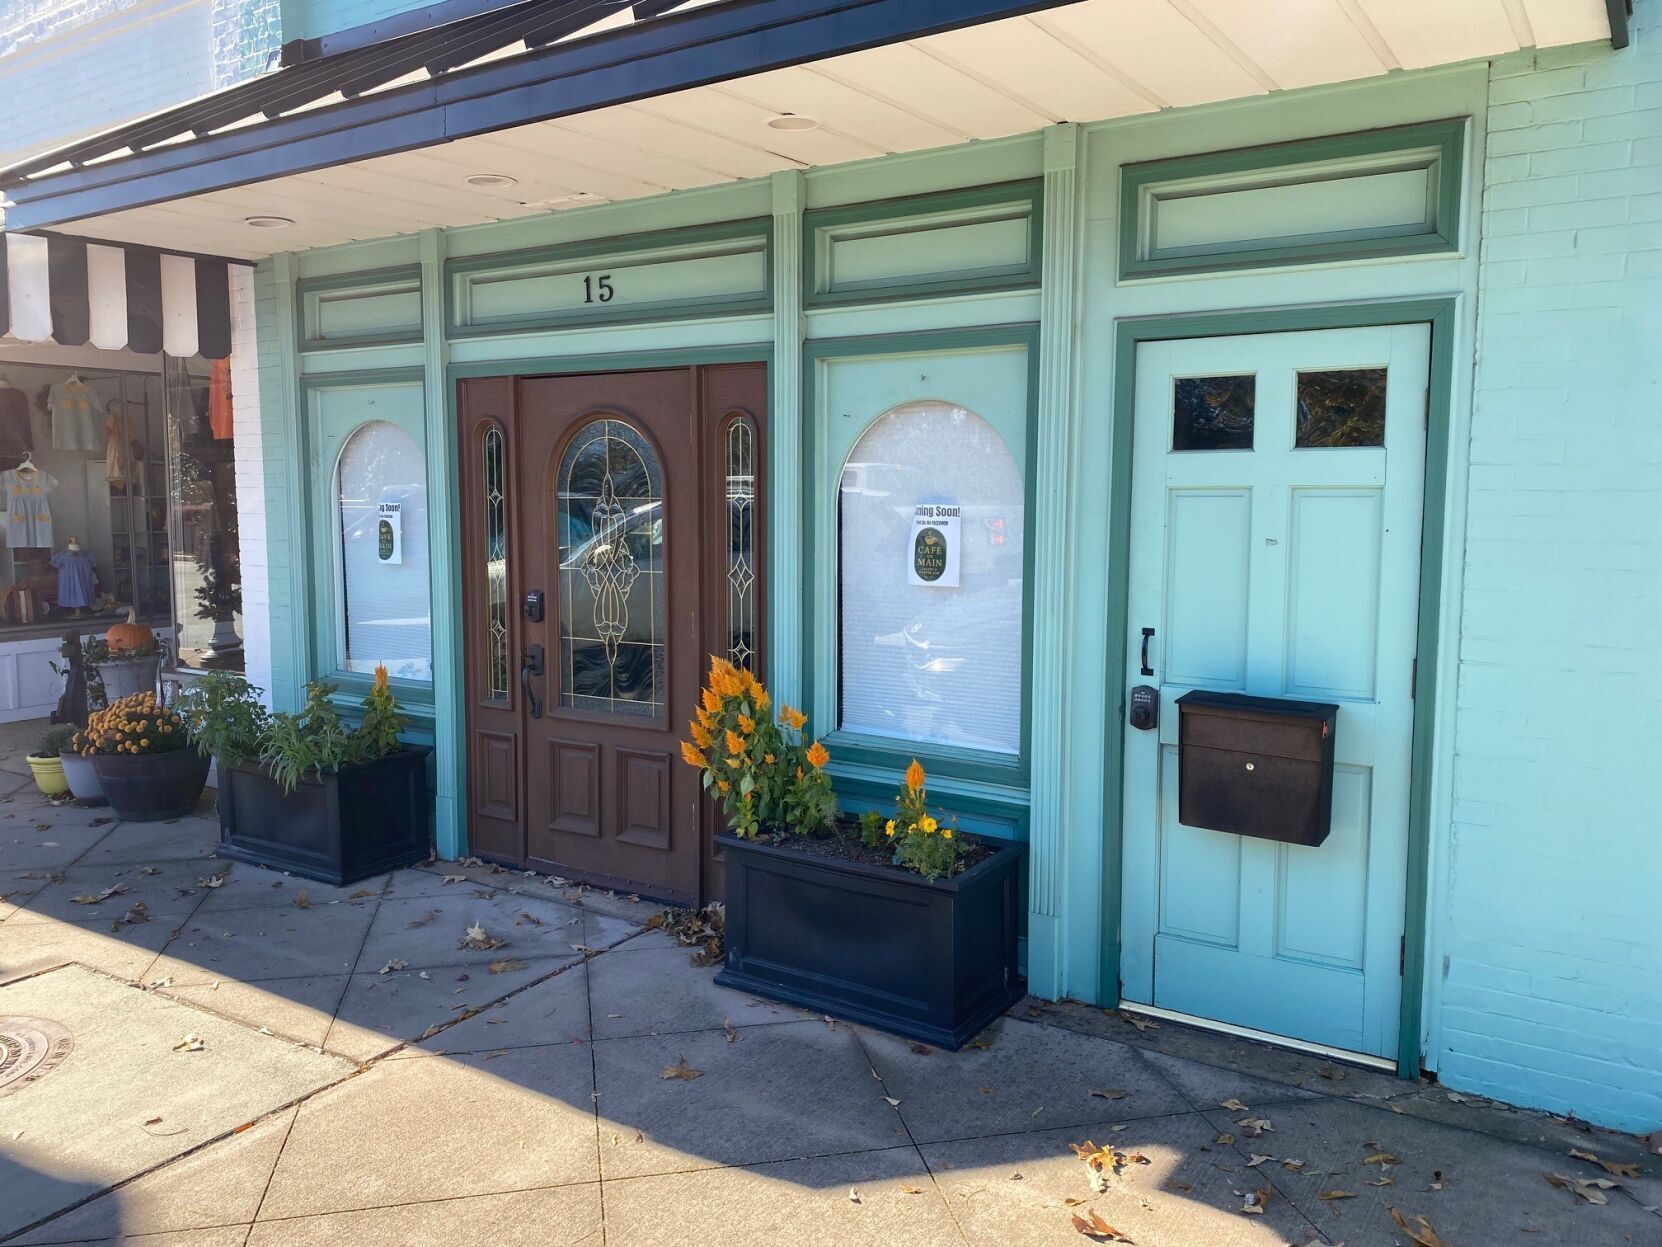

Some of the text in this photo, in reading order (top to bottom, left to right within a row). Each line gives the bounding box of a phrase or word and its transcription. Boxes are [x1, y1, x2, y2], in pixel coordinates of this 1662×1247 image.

[583, 274, 614, 304] 15
[935, 506, 961, 518] Soon!
[917, 546, 943, 555] CAFE
[917, 558, 942, 567] MAIN
